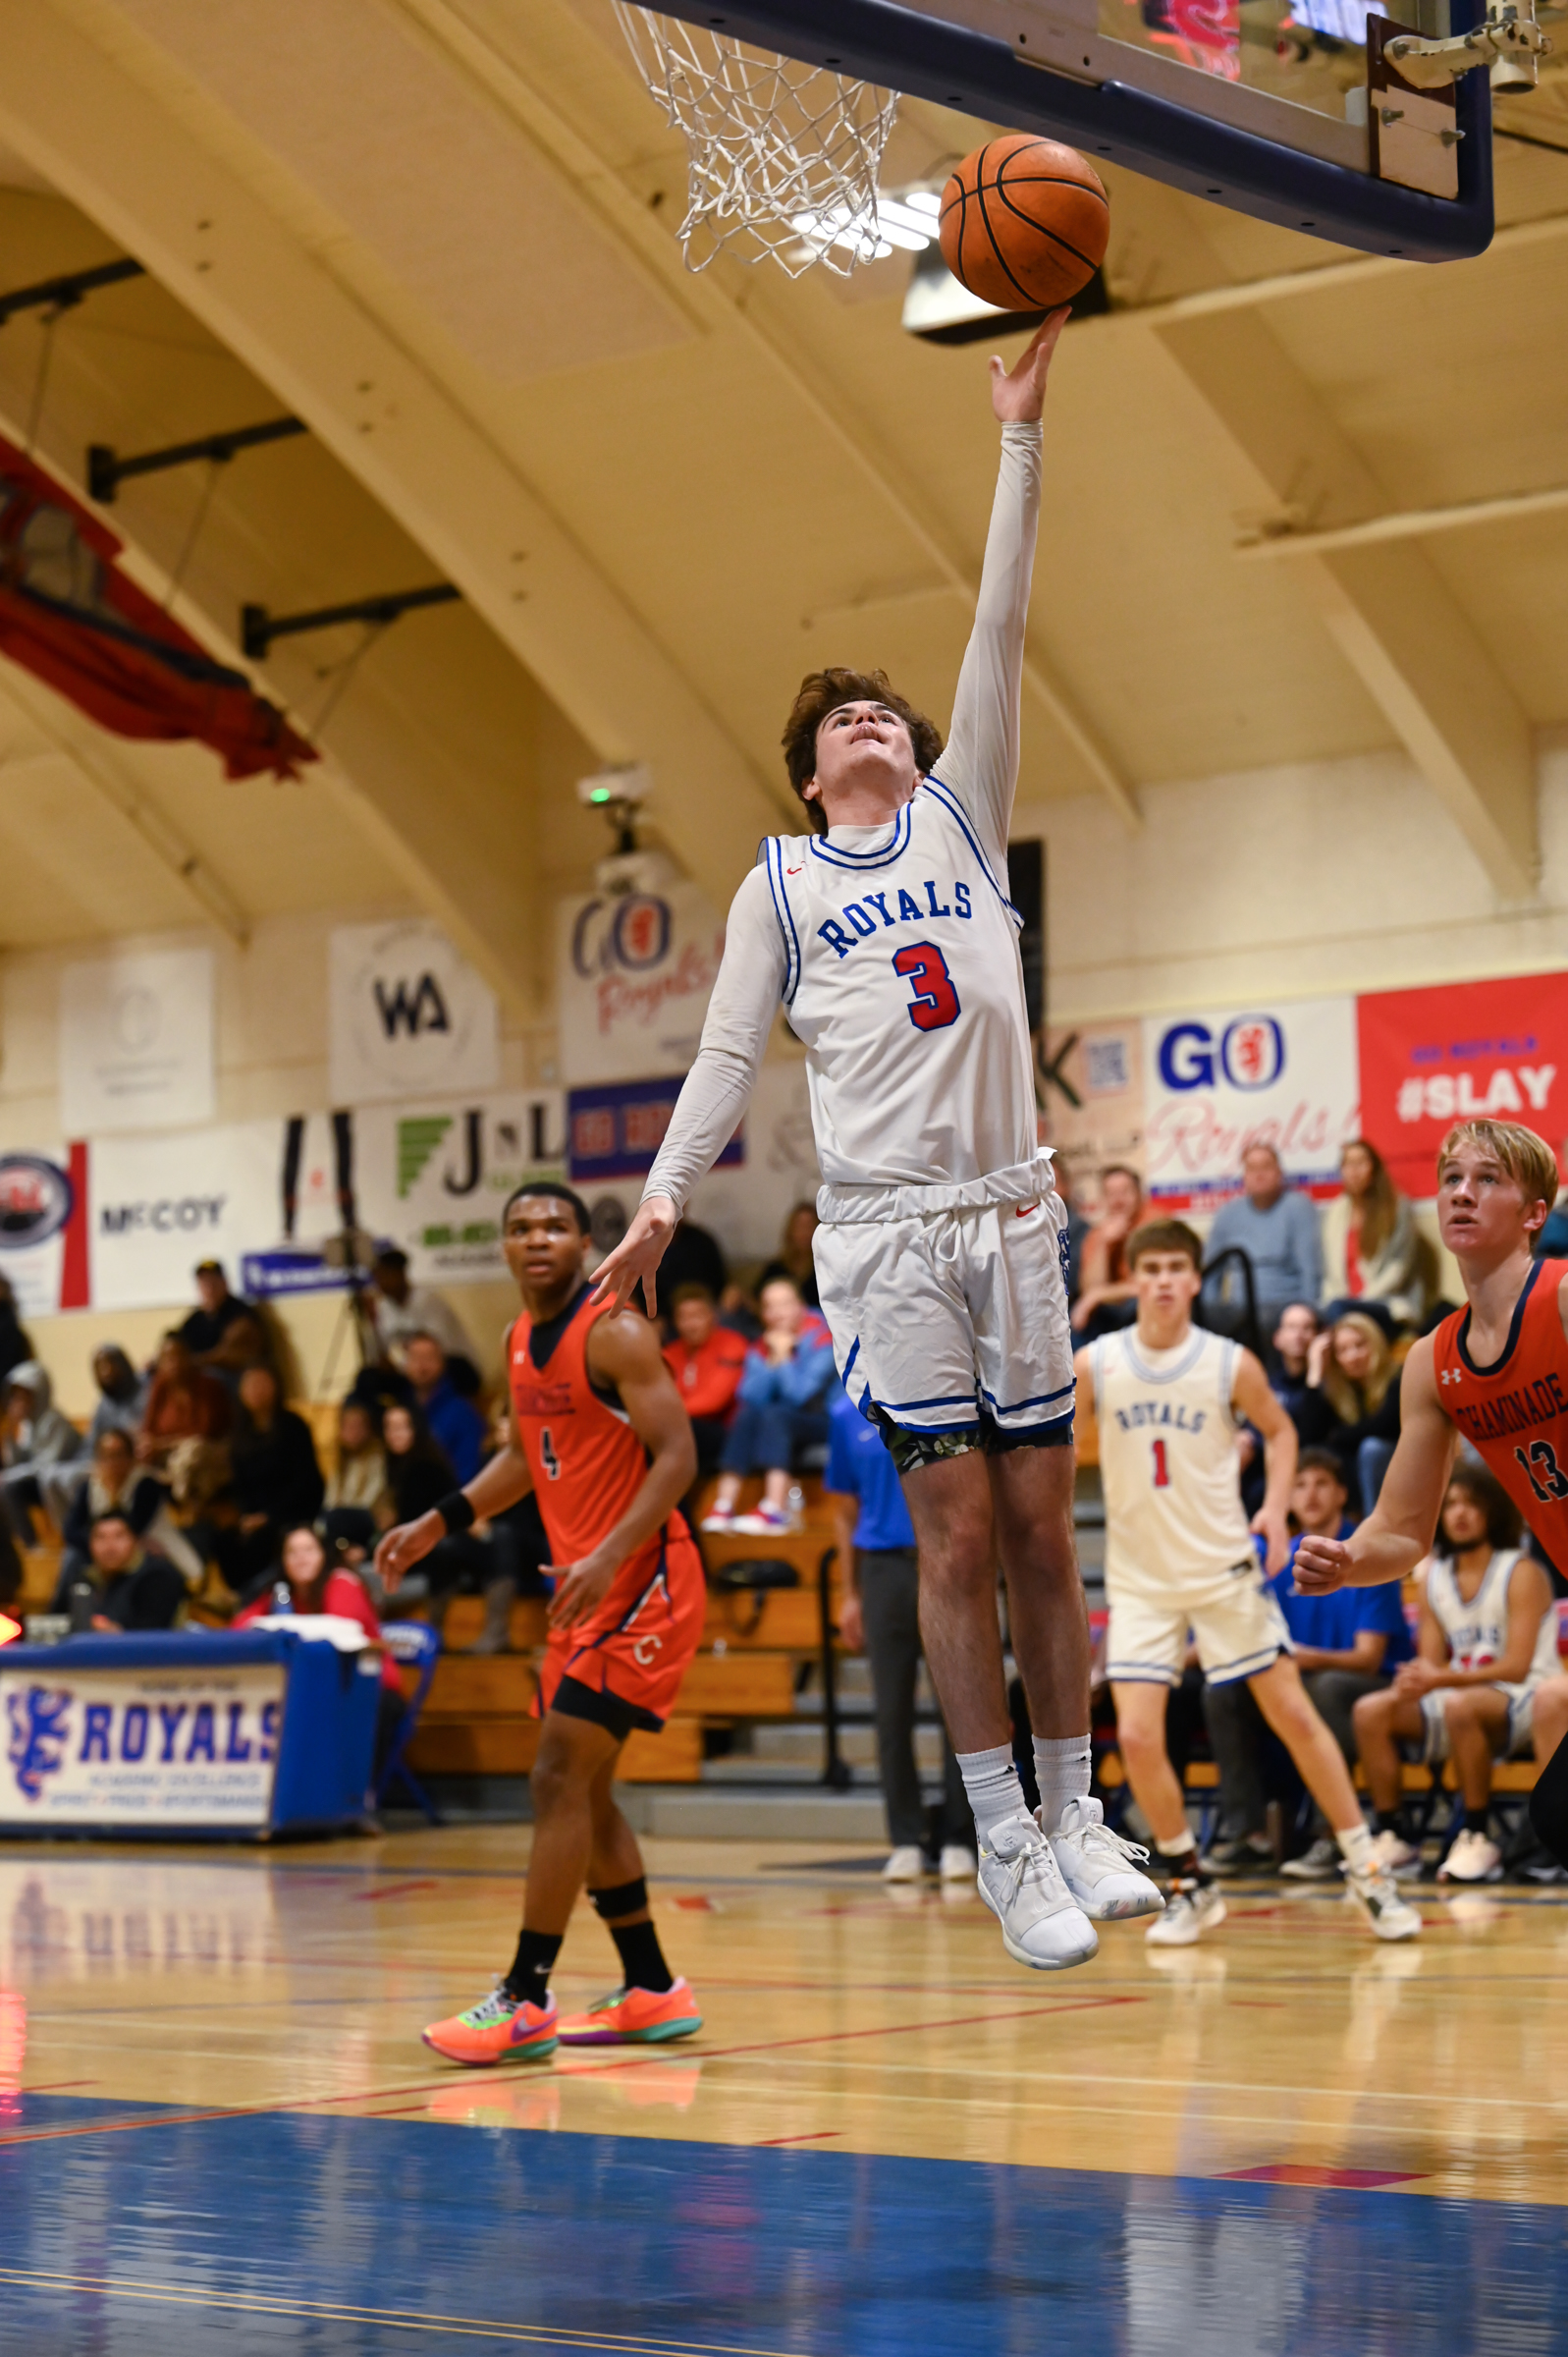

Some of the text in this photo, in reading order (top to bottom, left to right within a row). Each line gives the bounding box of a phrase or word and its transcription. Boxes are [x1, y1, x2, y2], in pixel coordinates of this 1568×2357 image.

[817, 880, 973, 959] ROYALS
[891, 940, 962, 1033] 3
[1157, 1014, 1285, 1092] GO
[1396, 1064, 1557, 1123] #SLAY
[541, 1427, 561, 1480] 4
[1152, 1439, 1169, 1487] 1
[1514, 1440, 1568, 1503] 13
